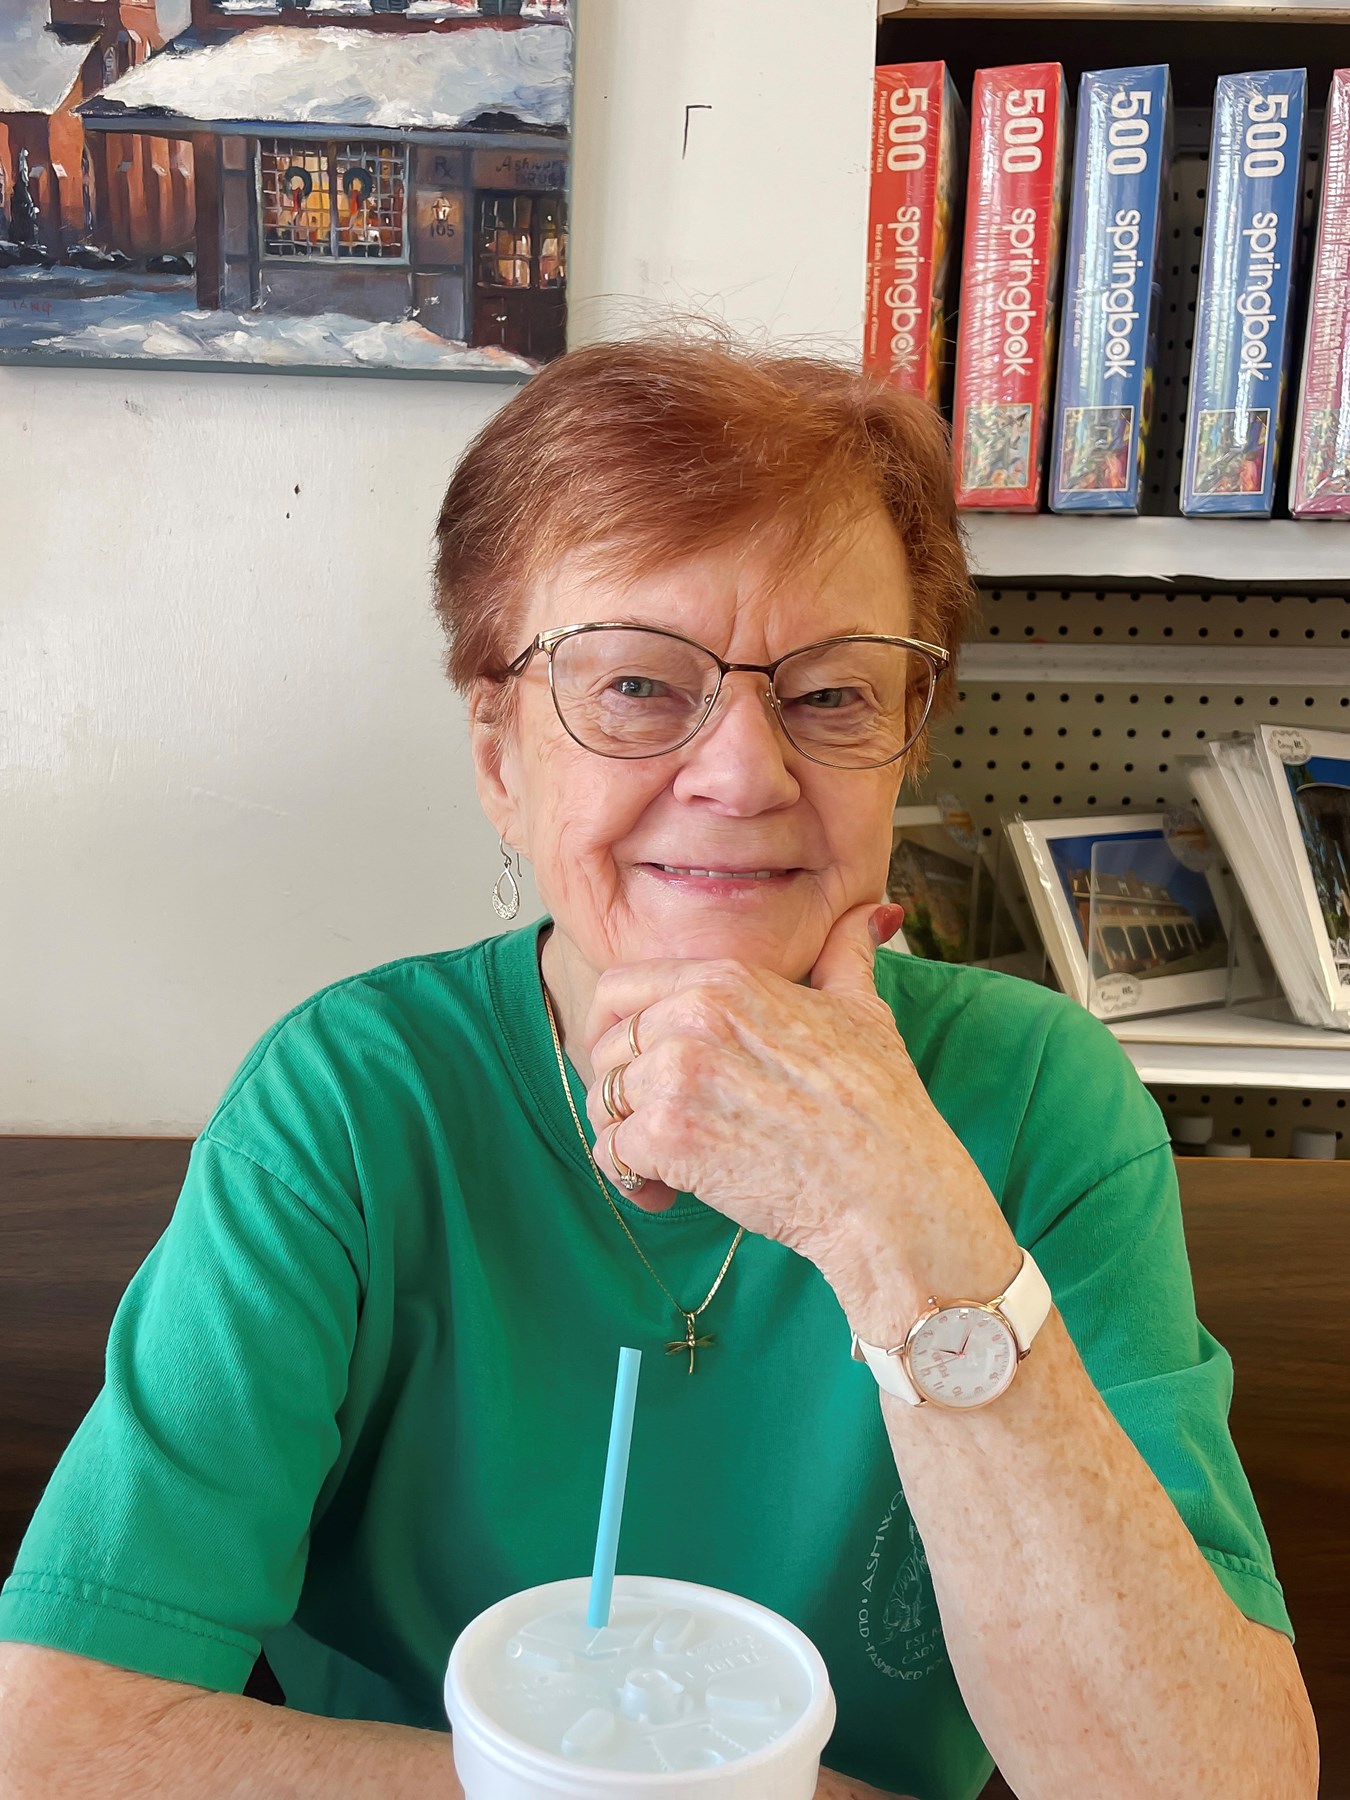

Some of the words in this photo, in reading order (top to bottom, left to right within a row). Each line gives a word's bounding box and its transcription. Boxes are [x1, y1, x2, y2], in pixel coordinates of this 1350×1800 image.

[887, 87, 929, 172] 500
[1002, 88, 1046, 174] 500
[1107, 90, 1152, 175] 500
[1243, 94, 1289, 178] 500
[430, 223, 455, 237] 105
[884, 206, 925, 373] springbok
[999, 207, 1041, 377] springbok
[1101, 209, 1144, 379] springbok
[1236, 212, 1281, 381] springbok
[861, 1490, 904, 1593] ASHWO
[858, 1608, 870, 1638] OLD
